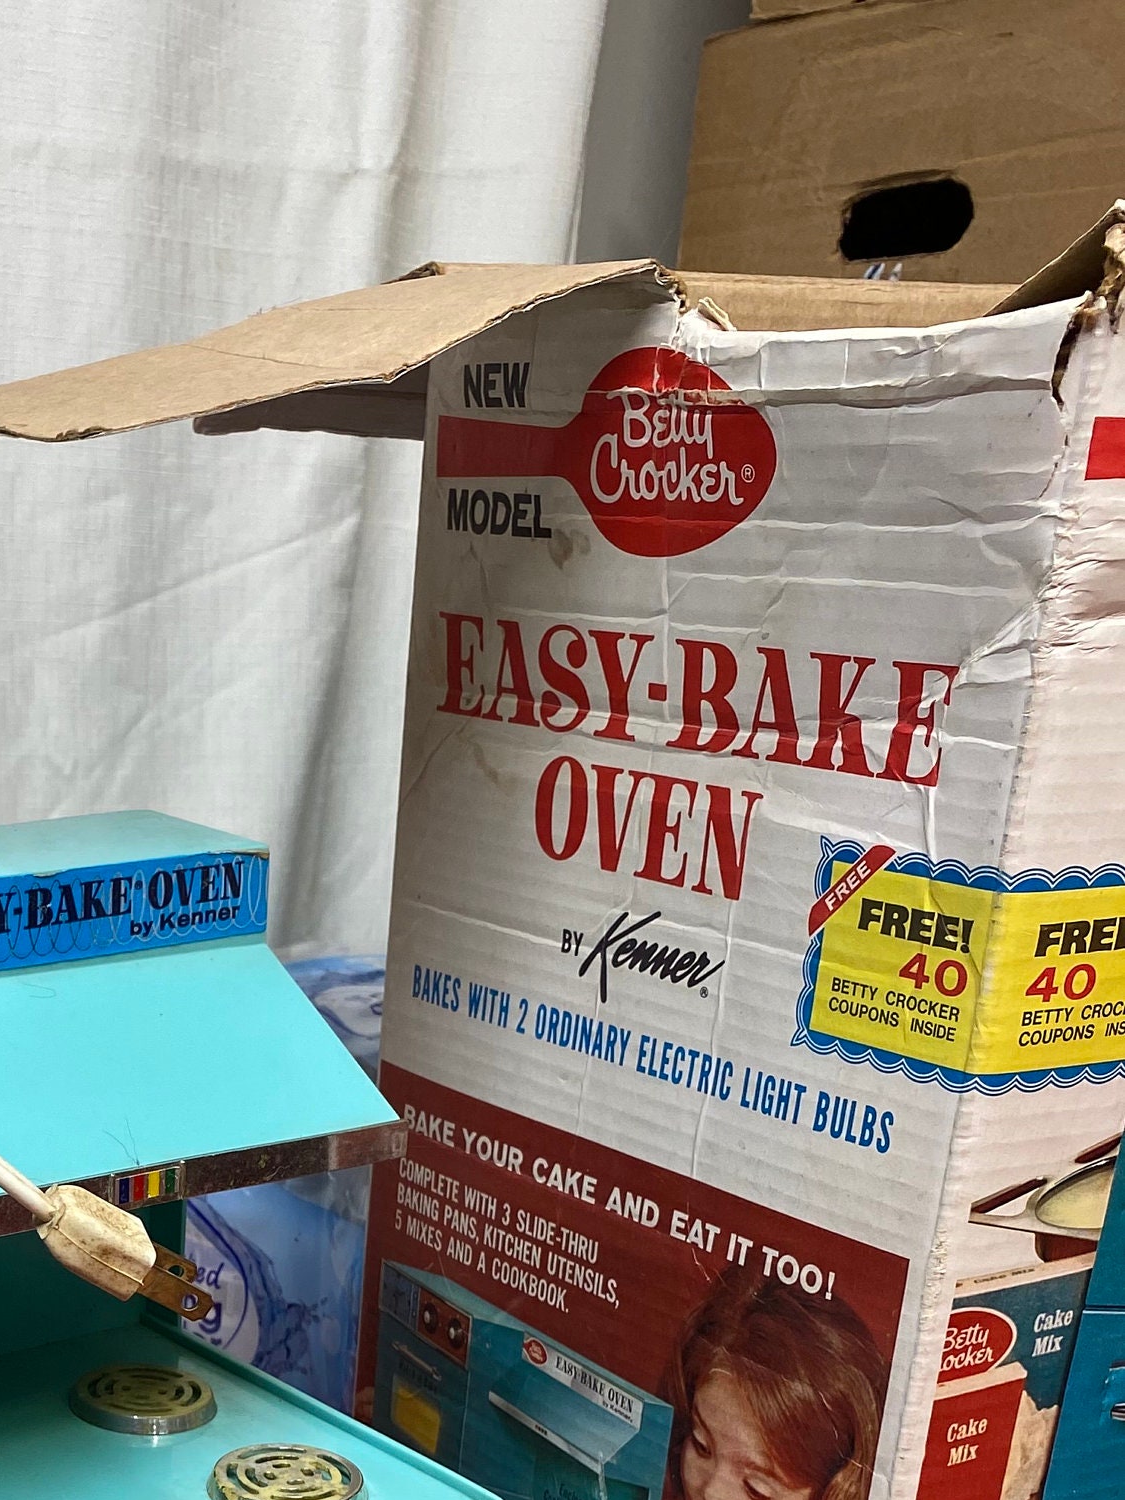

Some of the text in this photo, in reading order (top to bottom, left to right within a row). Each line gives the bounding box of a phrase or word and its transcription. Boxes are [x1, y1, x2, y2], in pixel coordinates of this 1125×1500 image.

[463, 363, 529, 408] NEW
[606, 386, 713, 459] Betty
[446, 488, 551, 538] MODEL
[437, 611, 960, 788] EASY-BAKE
[534, 756, 763, 900] OVEN
[148, 860, 245, 910] OVEN
[825, 861, 871, 911] FREE
[129, 904, 240, 939] by Kenner
[561, 929, 584, 956] BY
[858, 897, 974, 954] FREE!
[899, 952, 968, 997] 40
[1025, 964, 1096, 1002] 40
[828, 997, 956, 1042] COUPONS INSIDE
[831, 977, 960, 1022] BETTY CROCKER
[1021, 1001, 1125, 1026] BETTY CROC
[1019, 1024, 1095, 1047] COUPONS
[412, 964, 894, 1153] BAKES WITH 2 ORDINARY ELECTRIC LIGHT BULBS
[399, 1157, 599, 1264] COMPLETE WITH 3 SLIDE-THRU
[403, 1104, 836, 1301] BAKE YOUR CAKE AND EAT IT TOO!
[394, 1210, 569, 1313] 5 MIXES AND A COOKBOOK.
[397, 1182, 620, 1310] BAKING PANS, KITCHEN UTENSILS,
[943, 1322, 989, 1352] Betty
[1034, 1309, 1074, 1333] Cake
[939, 1346, 994, 1371] ocker
[1032, 1334, 1064, 1357] Mix
[556, 1356, 633, 1413] EASY-BAKE OVEN
[947, 1418, 987, 1443] Cake
[946, 1444, 979, 1467] Mix
